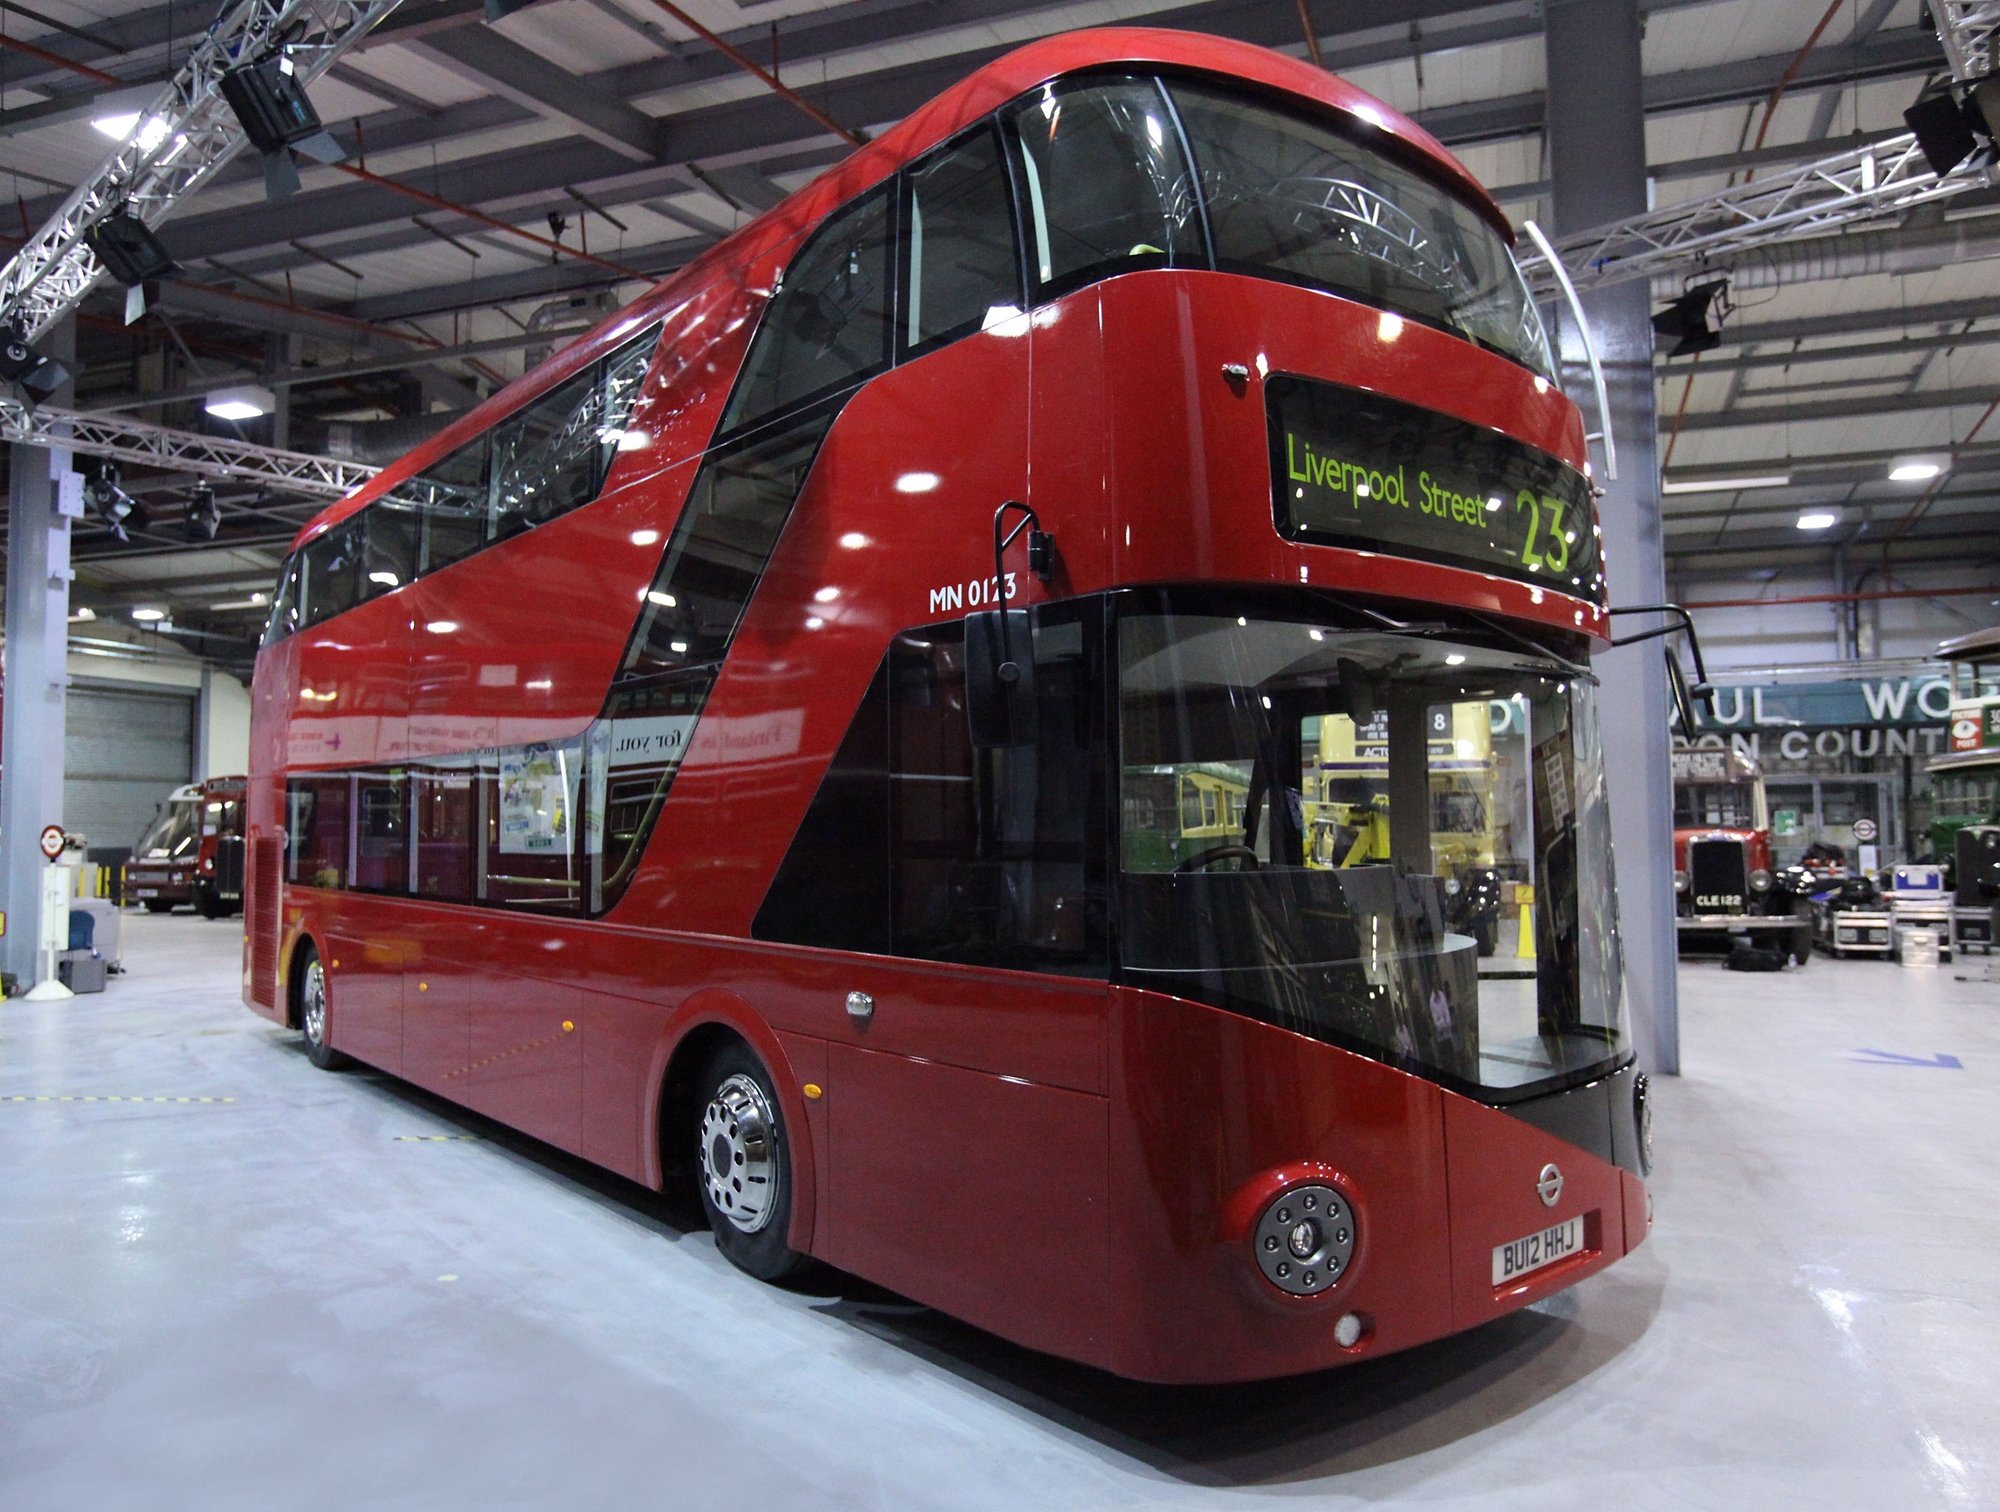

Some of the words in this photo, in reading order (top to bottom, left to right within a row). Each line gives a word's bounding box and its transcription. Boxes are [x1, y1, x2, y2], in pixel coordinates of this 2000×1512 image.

[1287, 432, 1409, 509] Liverpool
[1418, 470, 1487, 528] Street
[1516, 489, 1569, 573] 23
[929, 583, 963, 614] MN
[967, 572, 1017, 607] 0123
[1433, 713, 1446, 731] 8
[1696, 894, 1719, 907] CLE
[1720, 894, 1742, 907] 122
[1503, 1235, 1540, 1277] BU12
[1544, 1221, 1575, 1260] HHJ
